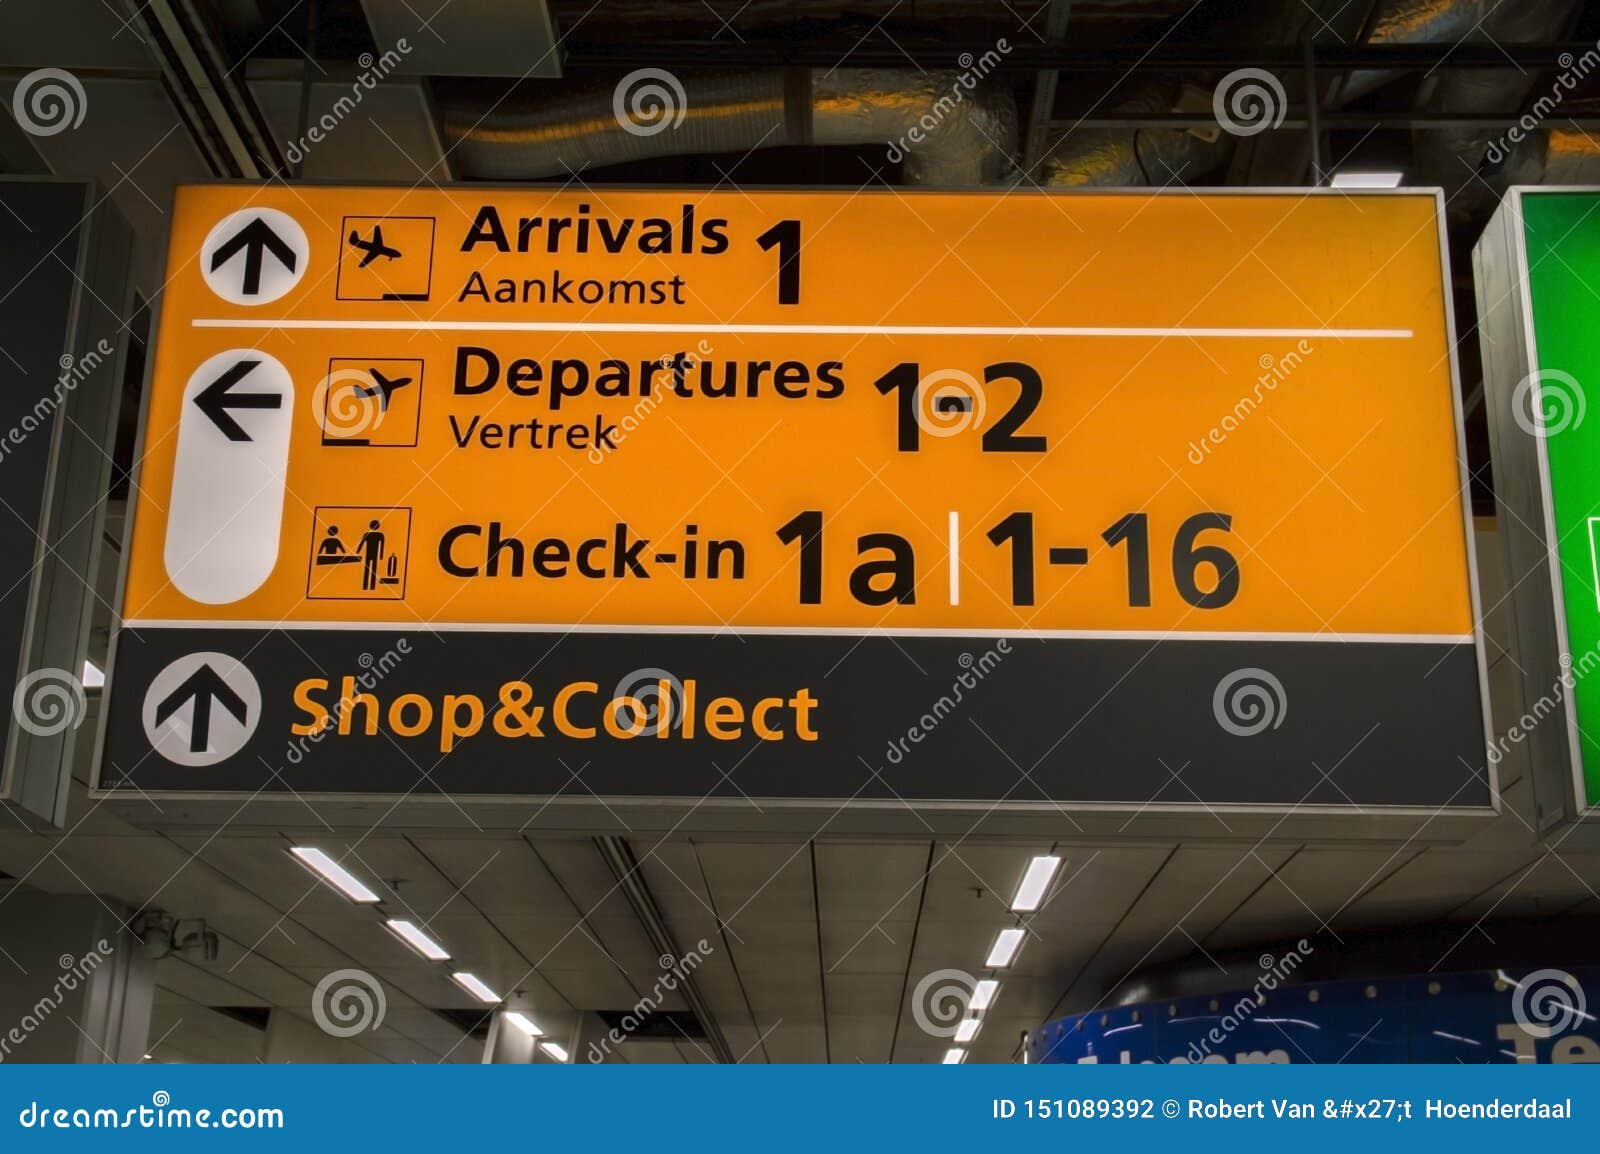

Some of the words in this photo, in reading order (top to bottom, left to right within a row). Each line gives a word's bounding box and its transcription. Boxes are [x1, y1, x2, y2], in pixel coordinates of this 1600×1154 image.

[458, 270, 686, 305] Aankomst
[460, 204, 729, 255] Arrivals
[756, 220, 801, 305] 1
[449, 415, 618, 450] Vertrek
[453, 346, 845, 411] Departures
[874, 361, 1048, 454] 1-2
[438, 522, 745, 580] Check-in
[775, 511, 917, 607] 1a
[986, 511, 1240, 610] 1-16
[290, 676, 820, 753] Shop&Collect
